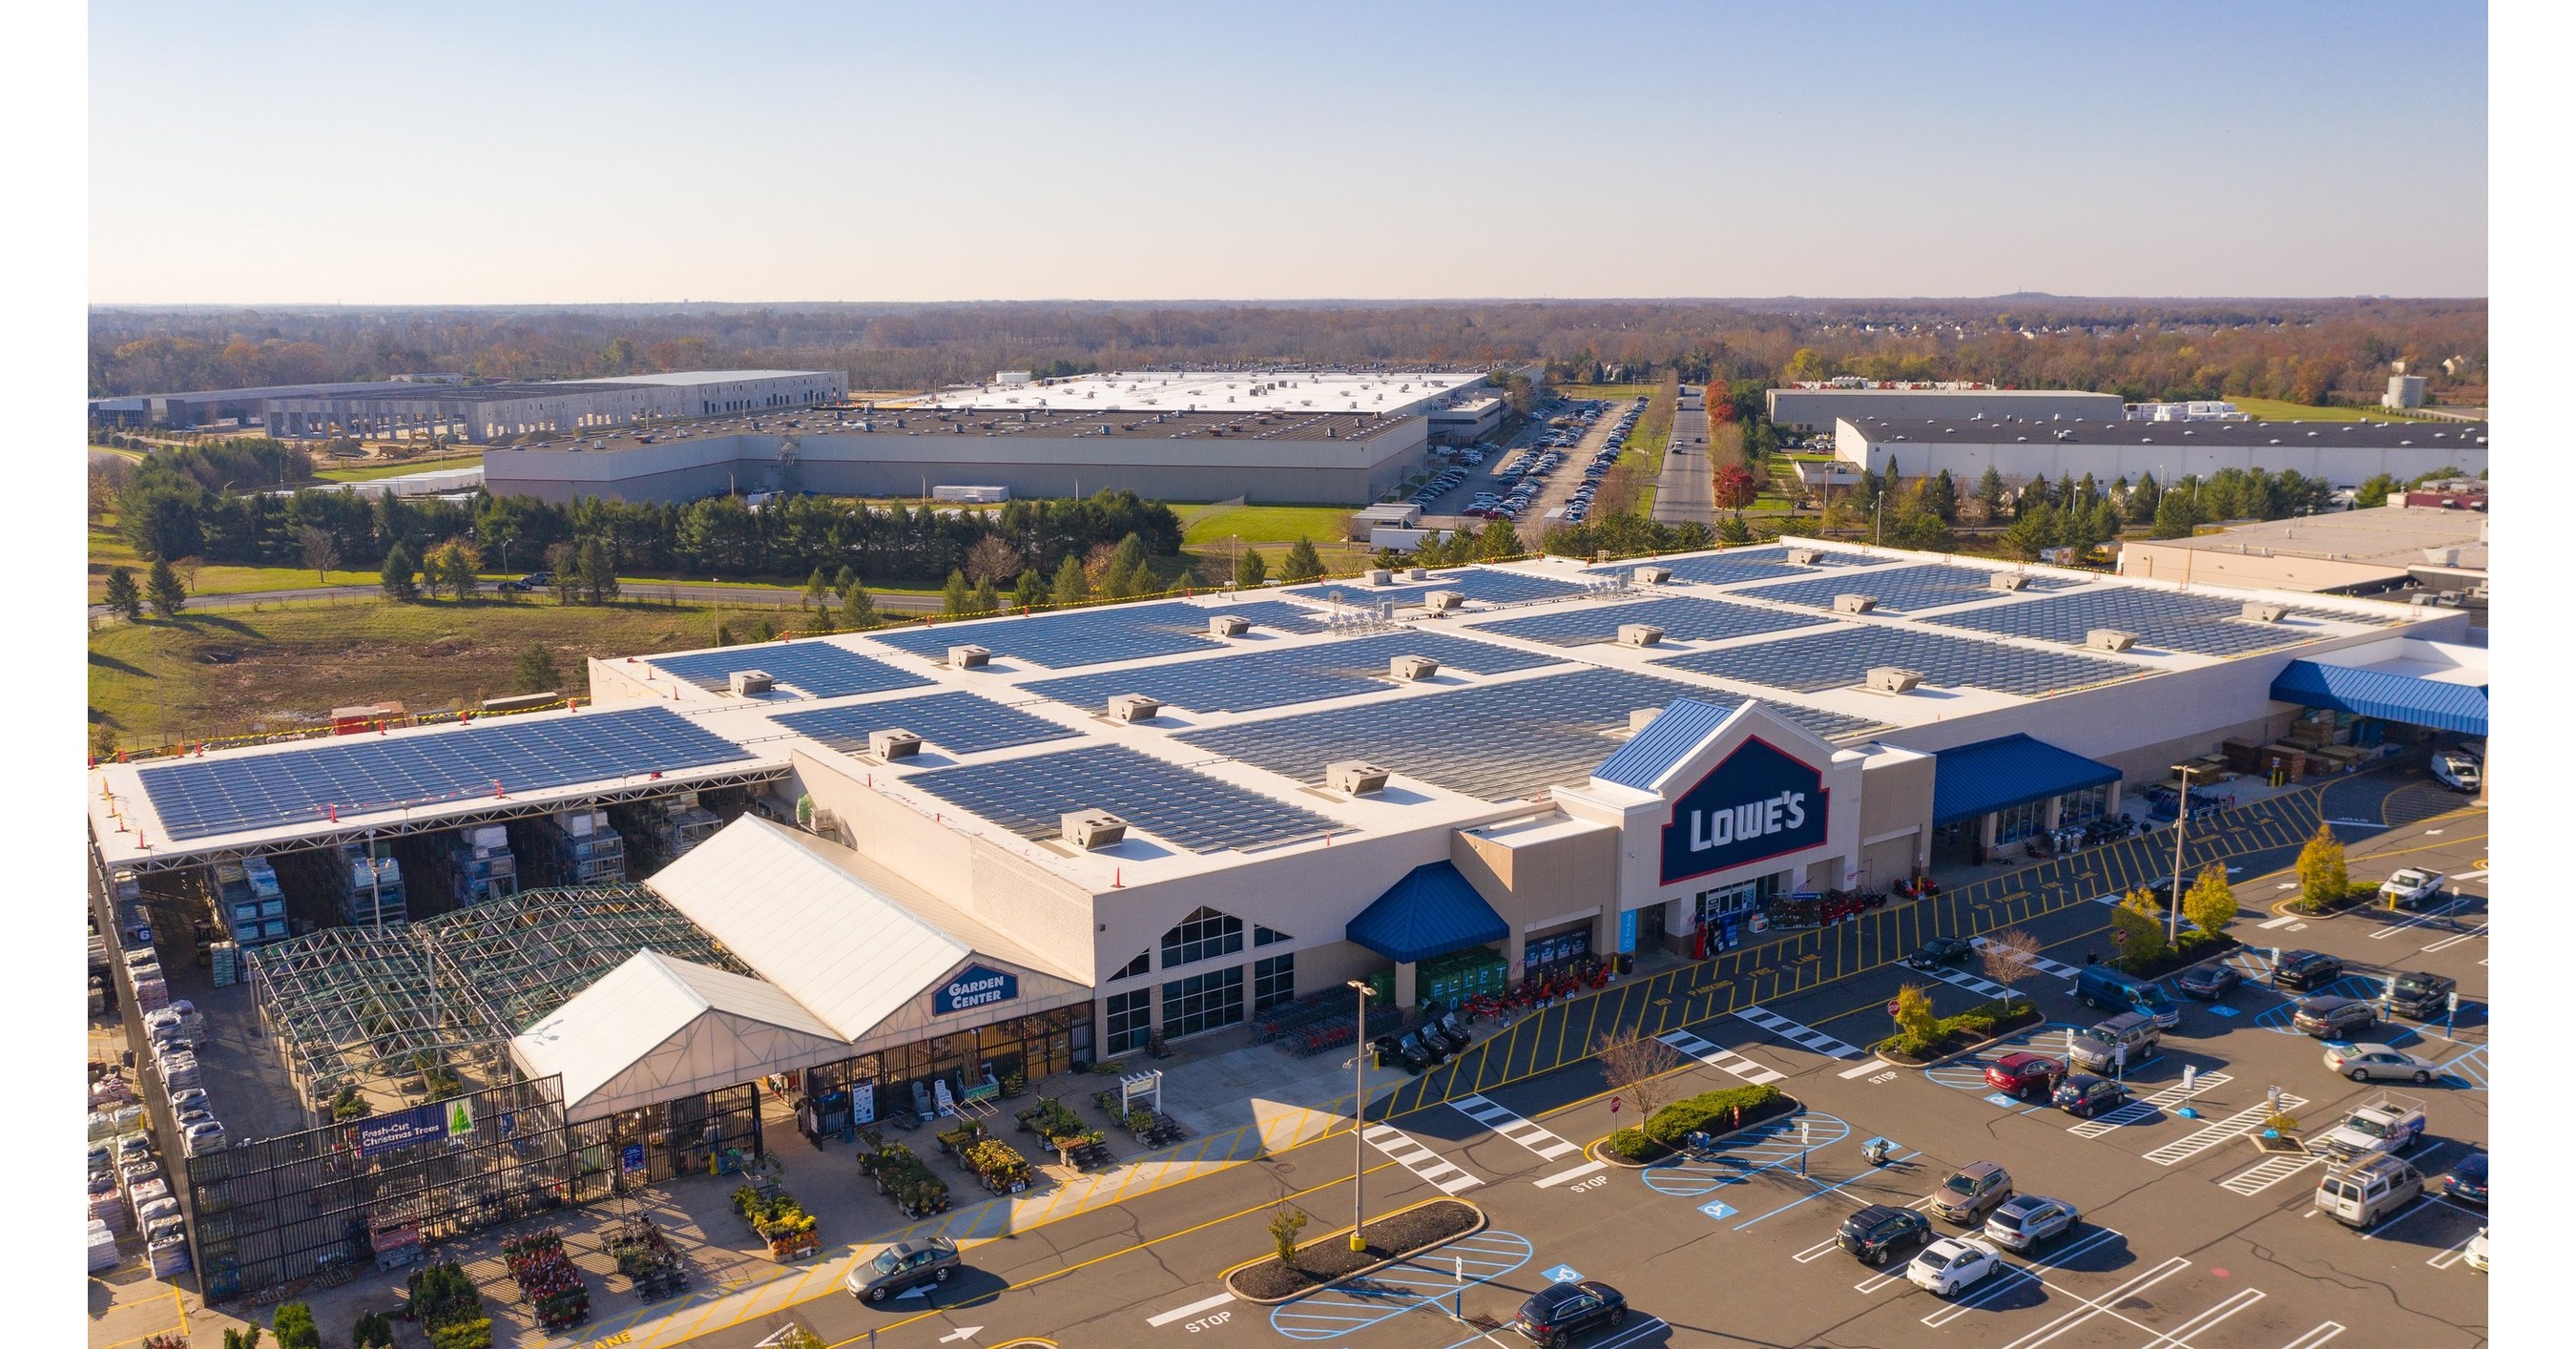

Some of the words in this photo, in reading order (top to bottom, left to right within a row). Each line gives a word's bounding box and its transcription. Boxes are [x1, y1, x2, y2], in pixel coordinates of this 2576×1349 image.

[1690, 790, 1804, 852] LOWE'S
[139, 930, 150, 940] 6
[948, 976, 1004, 996] GARDEN
[1686, 979, 1735, 997] PARKING
[1747, 966, 1776, 978] FIRE
[952, 990, 1002, 1009] CENTER
[1868, 1070, 1898, 1085] STOP
[362, 1122, 409, 1140] Fresh-Cut
[363, 1130, 413, 1147] Christmas
[413, 1124, 440, 1136] Trees
[1570, 1175, 1608, 1193] STOP
[1184, 1311, 1232, 1333] STOP
